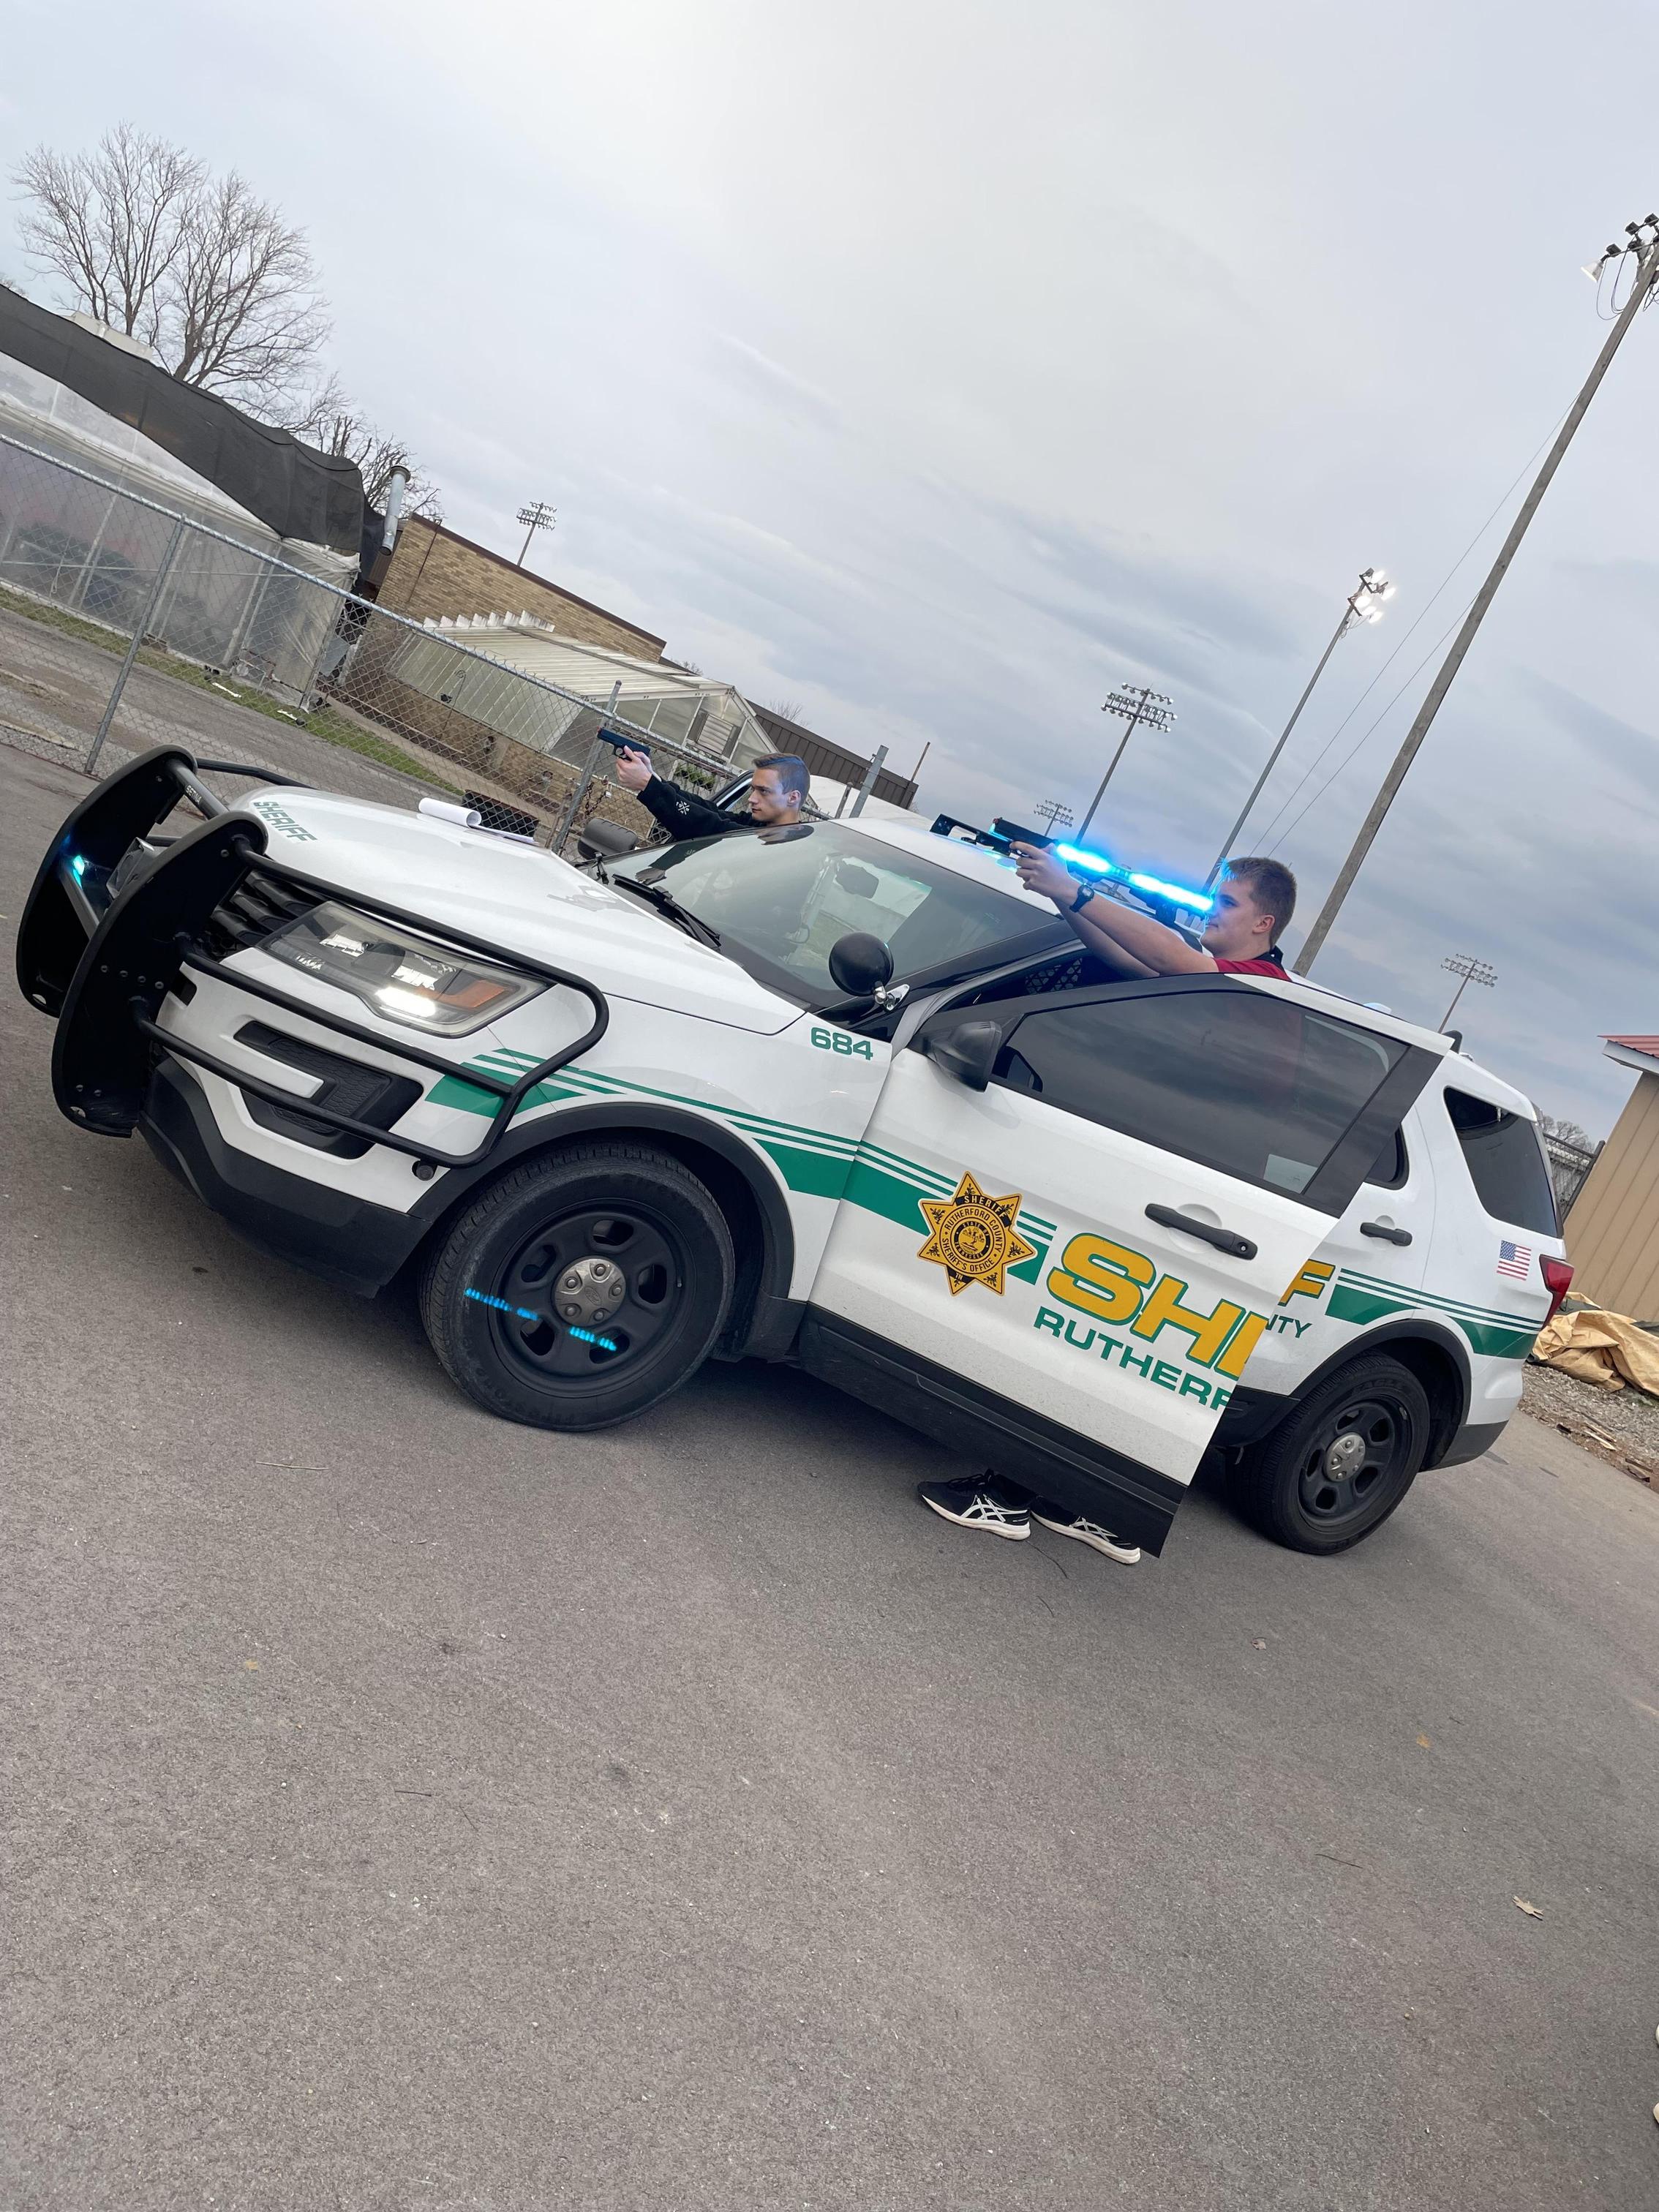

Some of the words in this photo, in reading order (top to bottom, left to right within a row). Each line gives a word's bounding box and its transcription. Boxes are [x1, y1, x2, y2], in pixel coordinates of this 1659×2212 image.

[253, 801, 318, 841] SHERIFF
[810, 1026, 873, 1061] 684
[964, 1195, 1007, 1218] SHERIFF
[944, 1208, 990, 1230] RUTHERFORD
[989, 1219, 1003, 1252] COUNTY
[942, 1238, 967, 1271] SHERIFF'S
[970, 1258, 995, 1272] OFFICE
